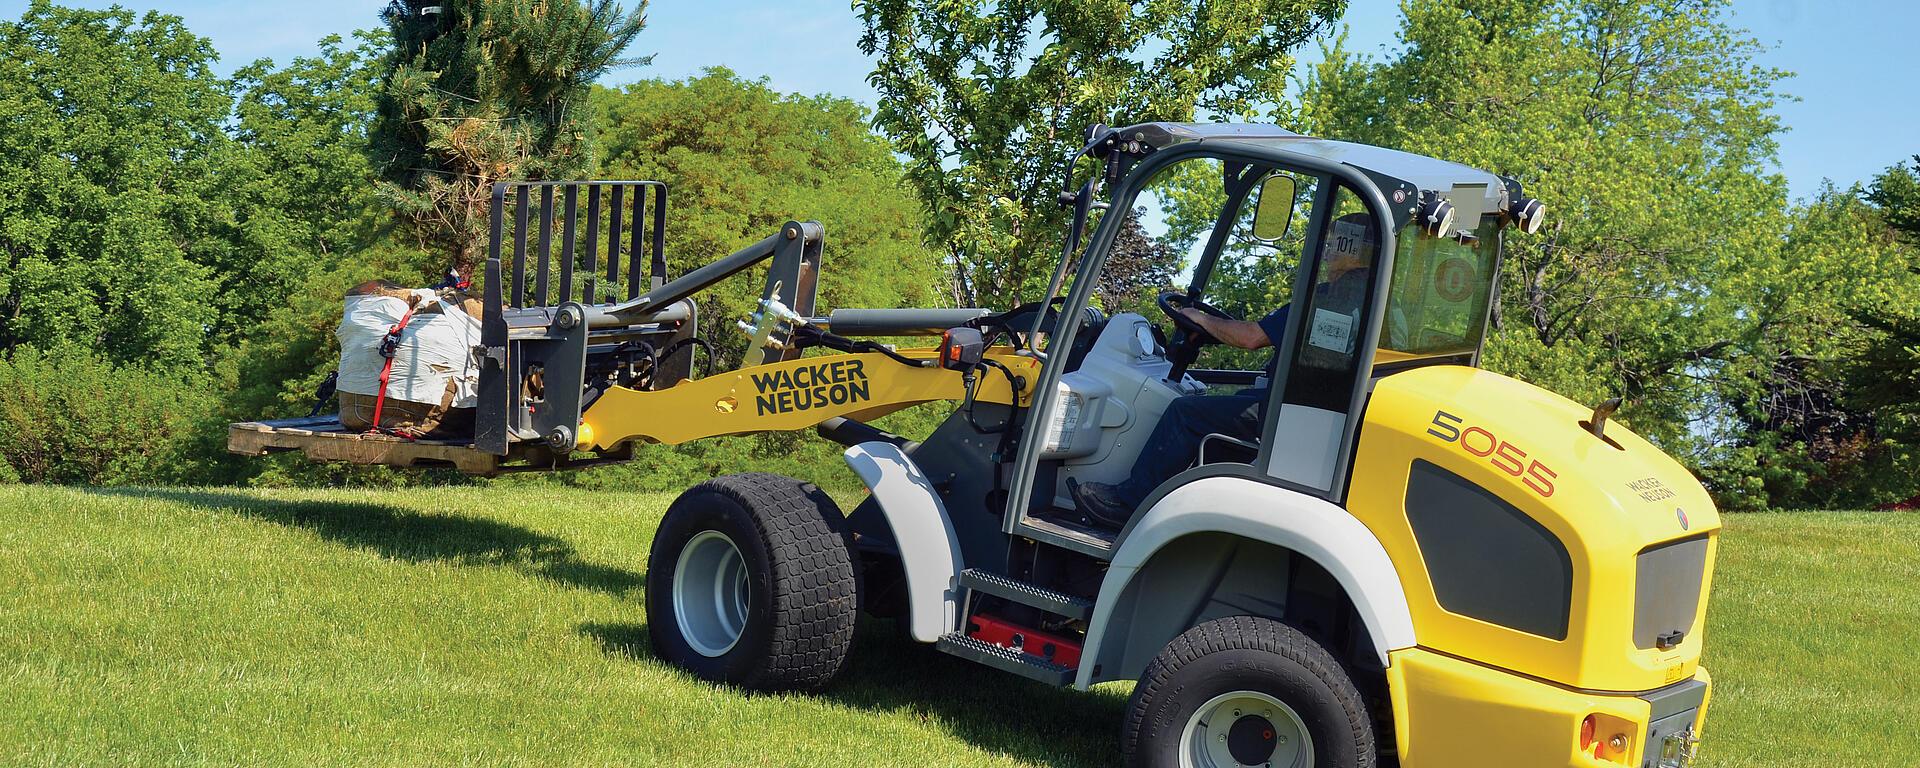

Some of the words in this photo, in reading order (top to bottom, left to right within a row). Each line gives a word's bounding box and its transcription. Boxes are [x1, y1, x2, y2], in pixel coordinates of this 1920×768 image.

[1336, 235, 1354, 255] 101
[751, 359, 867, 394] WACKER
[756, 380, 870, 416] NEUSON
[1426, 410, 1558, 498] 5055
[1625, 477, 1665, 492] WACKER
[1639, 488, 1677, 503] NEUSON
